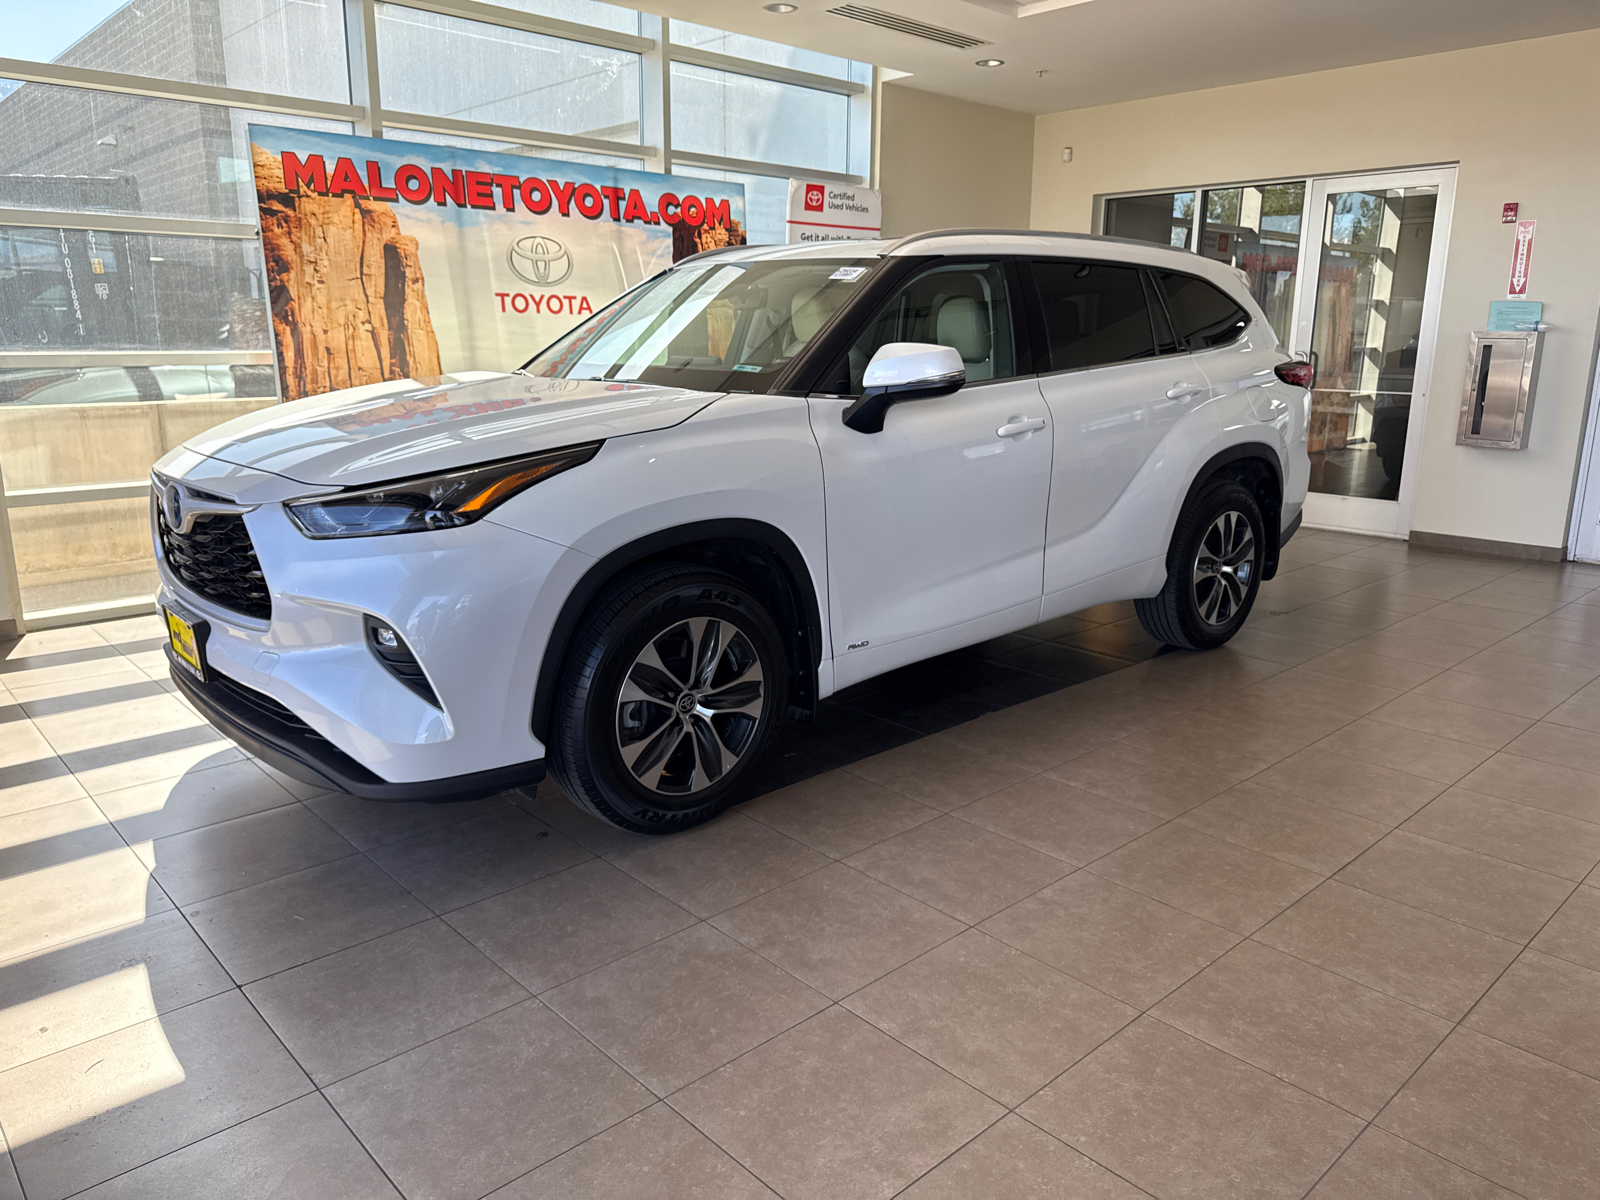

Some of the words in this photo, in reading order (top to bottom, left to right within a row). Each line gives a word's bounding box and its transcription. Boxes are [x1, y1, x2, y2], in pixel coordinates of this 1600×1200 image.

[281, 151, 732, 230] MALONETOYOTA.COM
[828, 190, 855, 201] Certified
[828, 201, 844, 210] Used
[845, 202, 869, 213] Vehicles
[800, 232, 814, 242] Get
[814, 233, 820, 242] it
[820, 233, 830, 241] all
[1516, 234, 1528, 288] EXTINGUISHER
[494, 292, 594, 316] TOYOTA
[694, 588, 743, 607] A43
[847, 640, 870, 651] AWD
